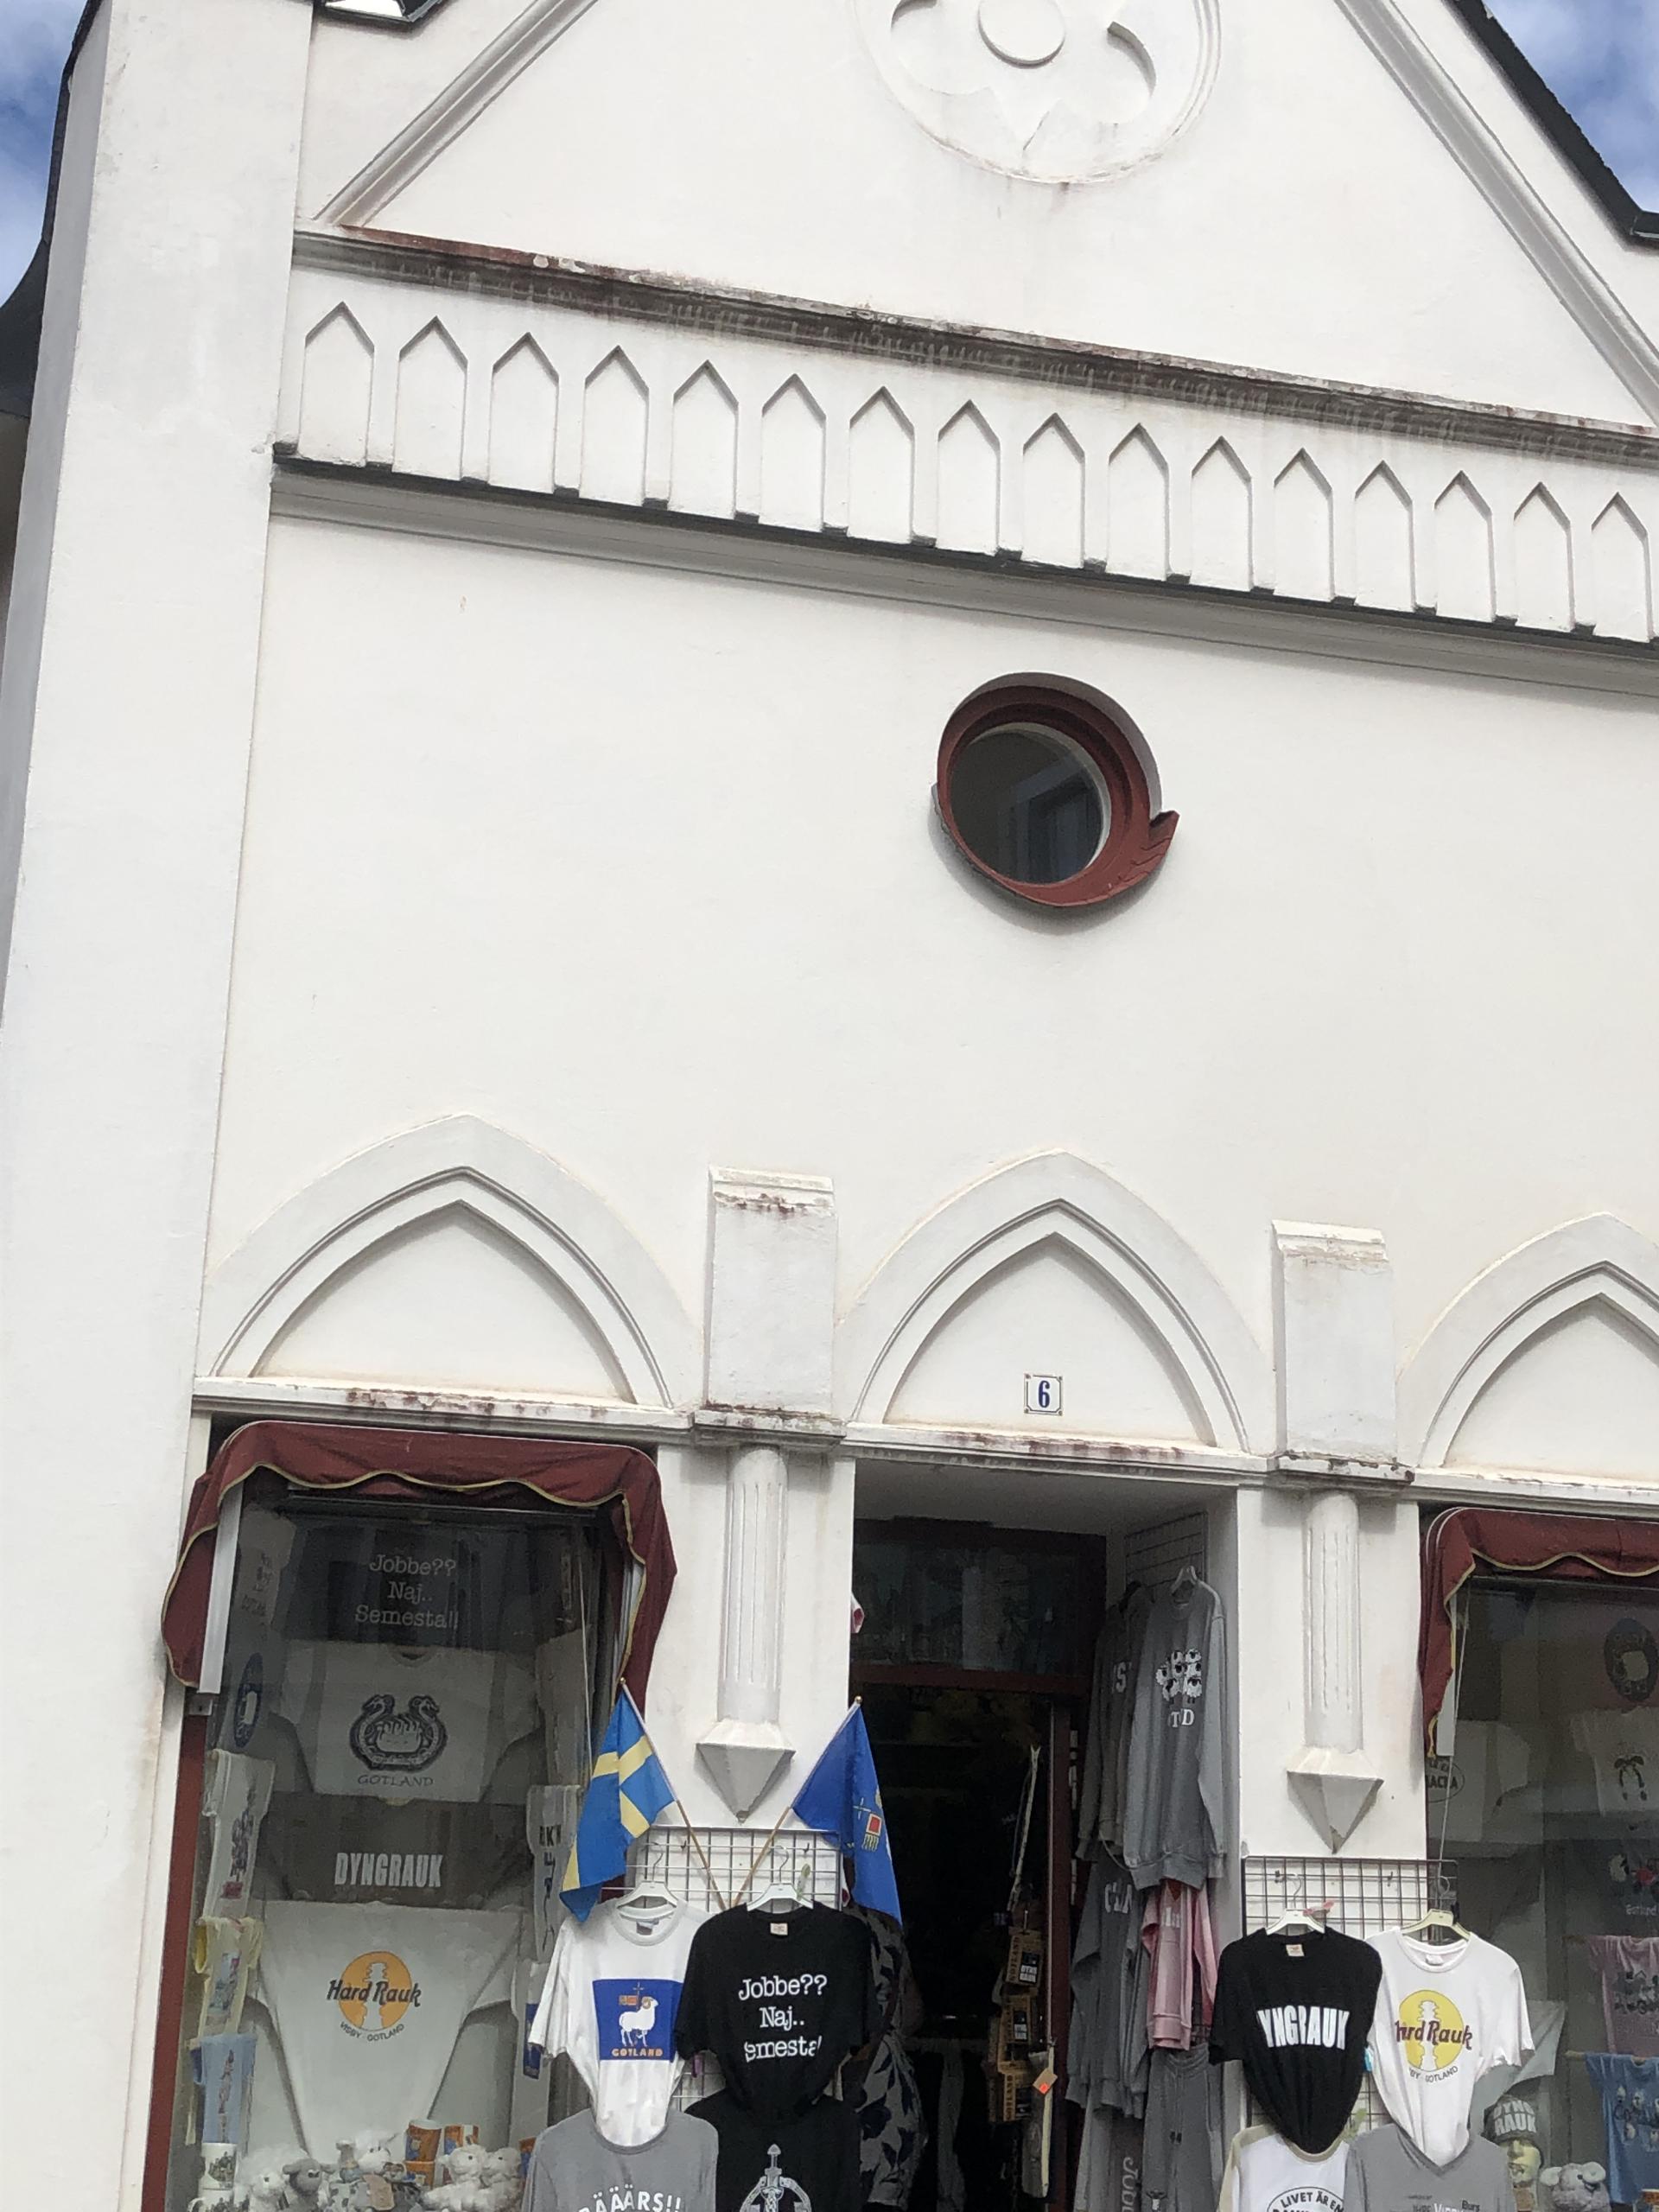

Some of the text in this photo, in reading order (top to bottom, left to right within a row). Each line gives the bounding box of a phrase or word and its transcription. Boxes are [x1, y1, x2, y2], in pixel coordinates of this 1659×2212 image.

[1039, 1380, 1050, 1408] 6
[369, 1554, 456, 1576] Jobbe??
[358, 1774, 434, 1787] GOTLAND
[334, 1852, 443, 1887] DYNGRAUK
[327, 1980, 422, 2007] Hard Rauk
[739, 1974, 828, 2000] Jobbe??
[760, 2005, 804, 2031] Naj..
[367, 2024, 404, 2042] GOTLAND
[1427, 2020, 1472, 2050] Rauk
[612, 2048, 663, 2056] GOTLAND
[1495, 2113, 1536, 2136] RAUK
[579, 2184, 681, 2212] ÄÄÄRS!!
[1281, 2192, 1313, 2208] LIVET
[1316, 2190, 1328, 2206] ÄR
